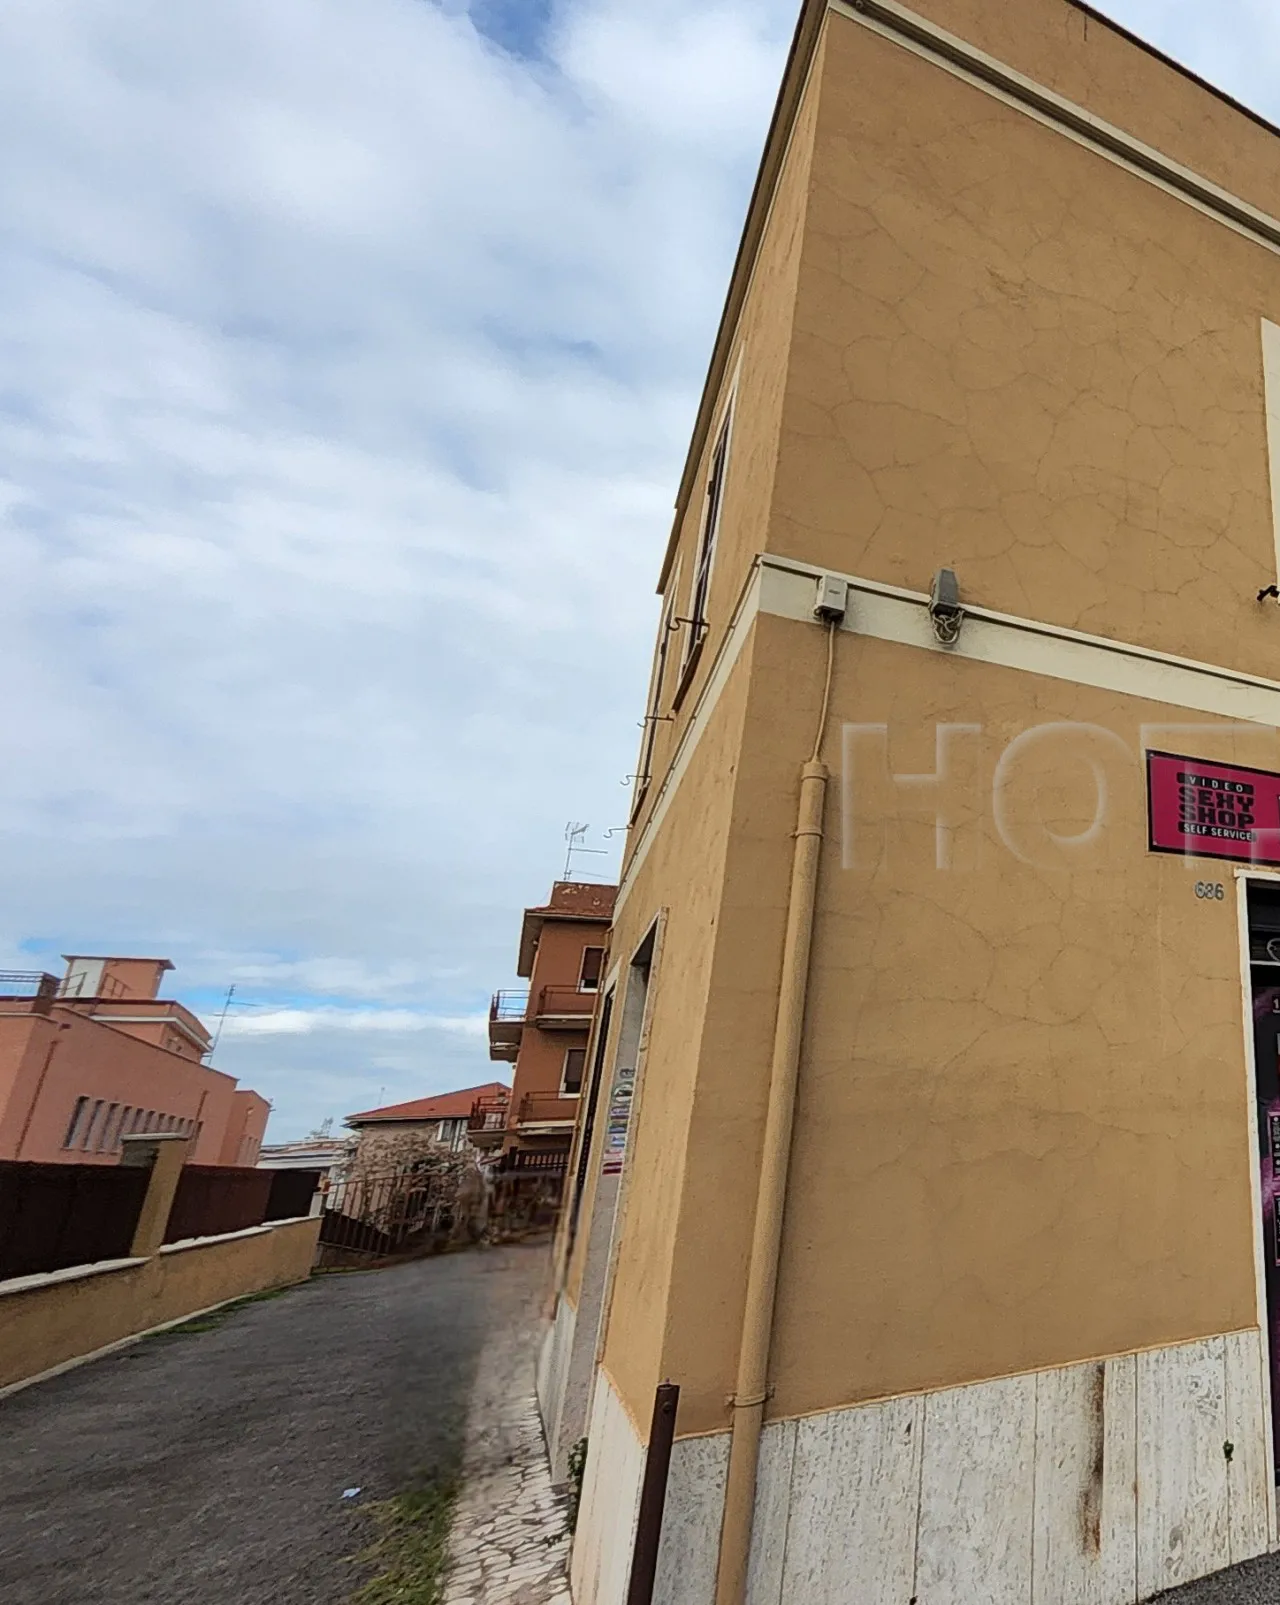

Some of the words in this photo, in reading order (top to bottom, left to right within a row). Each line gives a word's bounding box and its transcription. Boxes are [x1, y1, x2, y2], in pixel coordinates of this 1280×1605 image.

[1189, 776, 1243, 792] VIDEO
[1179, 786, 1254, 812] SEXY
[1179, 803, 1255, 828] SHOP
[1184, 823, 1207, 834] SELF
[1211, 827, 1252, 840] SERVICE
[1194, 881, 1225, 901] 686
